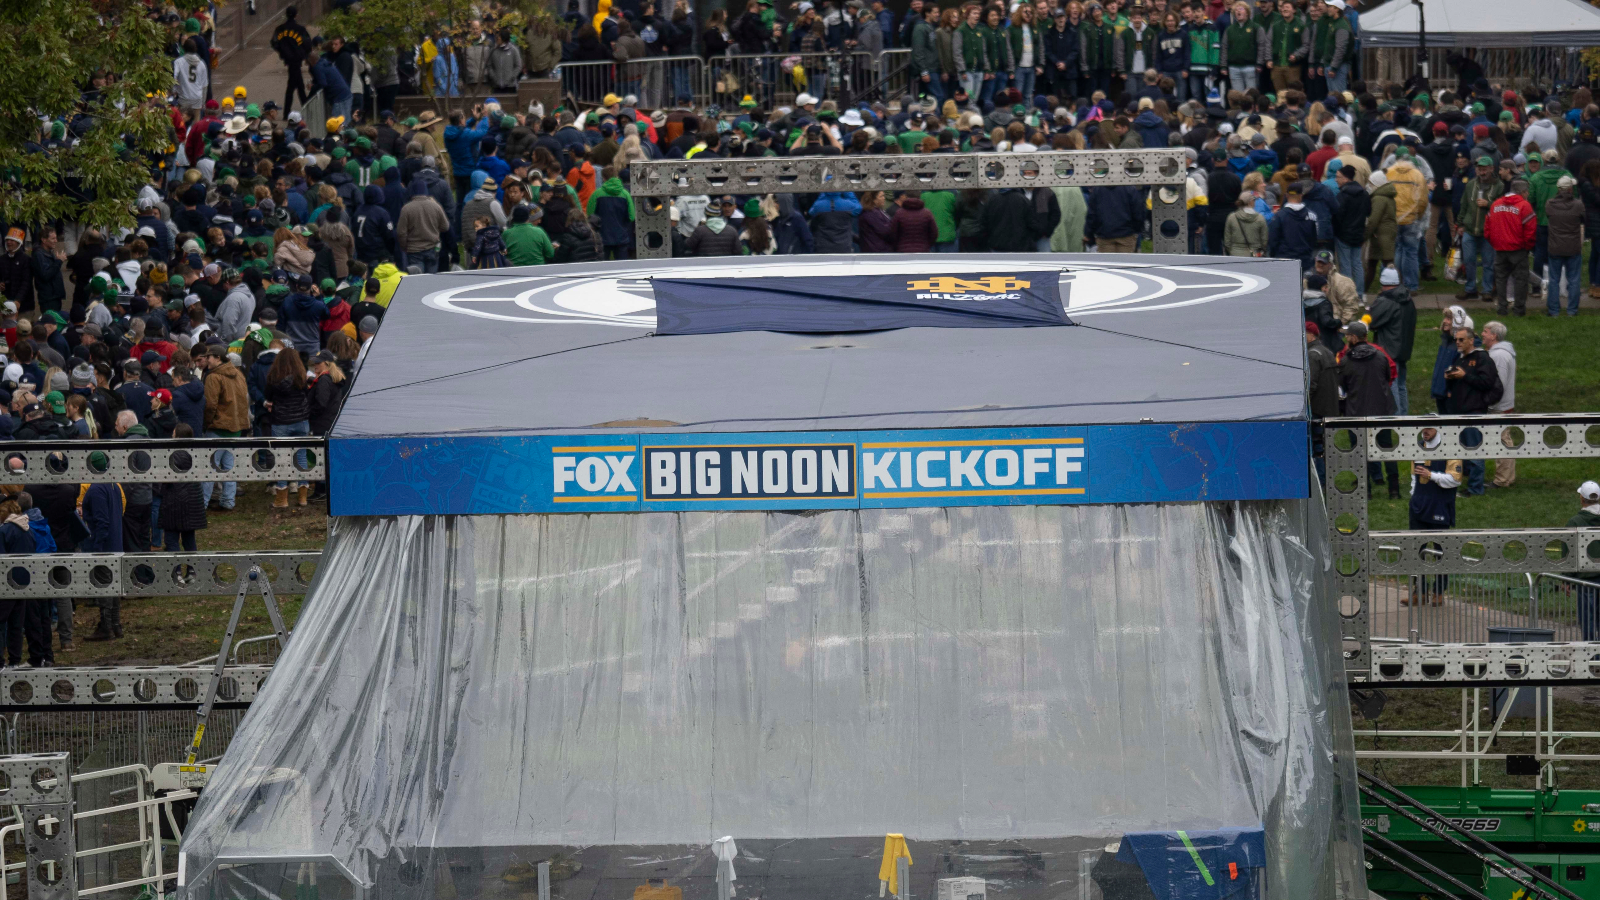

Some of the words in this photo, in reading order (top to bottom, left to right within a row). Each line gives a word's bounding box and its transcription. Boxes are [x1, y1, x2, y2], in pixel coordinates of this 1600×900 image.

[188, 65, 198, 83] 5
[358, 166, 371, 187] 11
[357, 215, 366, 237] 7
[553, 455, 637, 493] FOX
[650, 450, 721, 495] BIG
[731, 449, 849, 494] NOON
[862, 447, 1085, 489] KICKOFF
